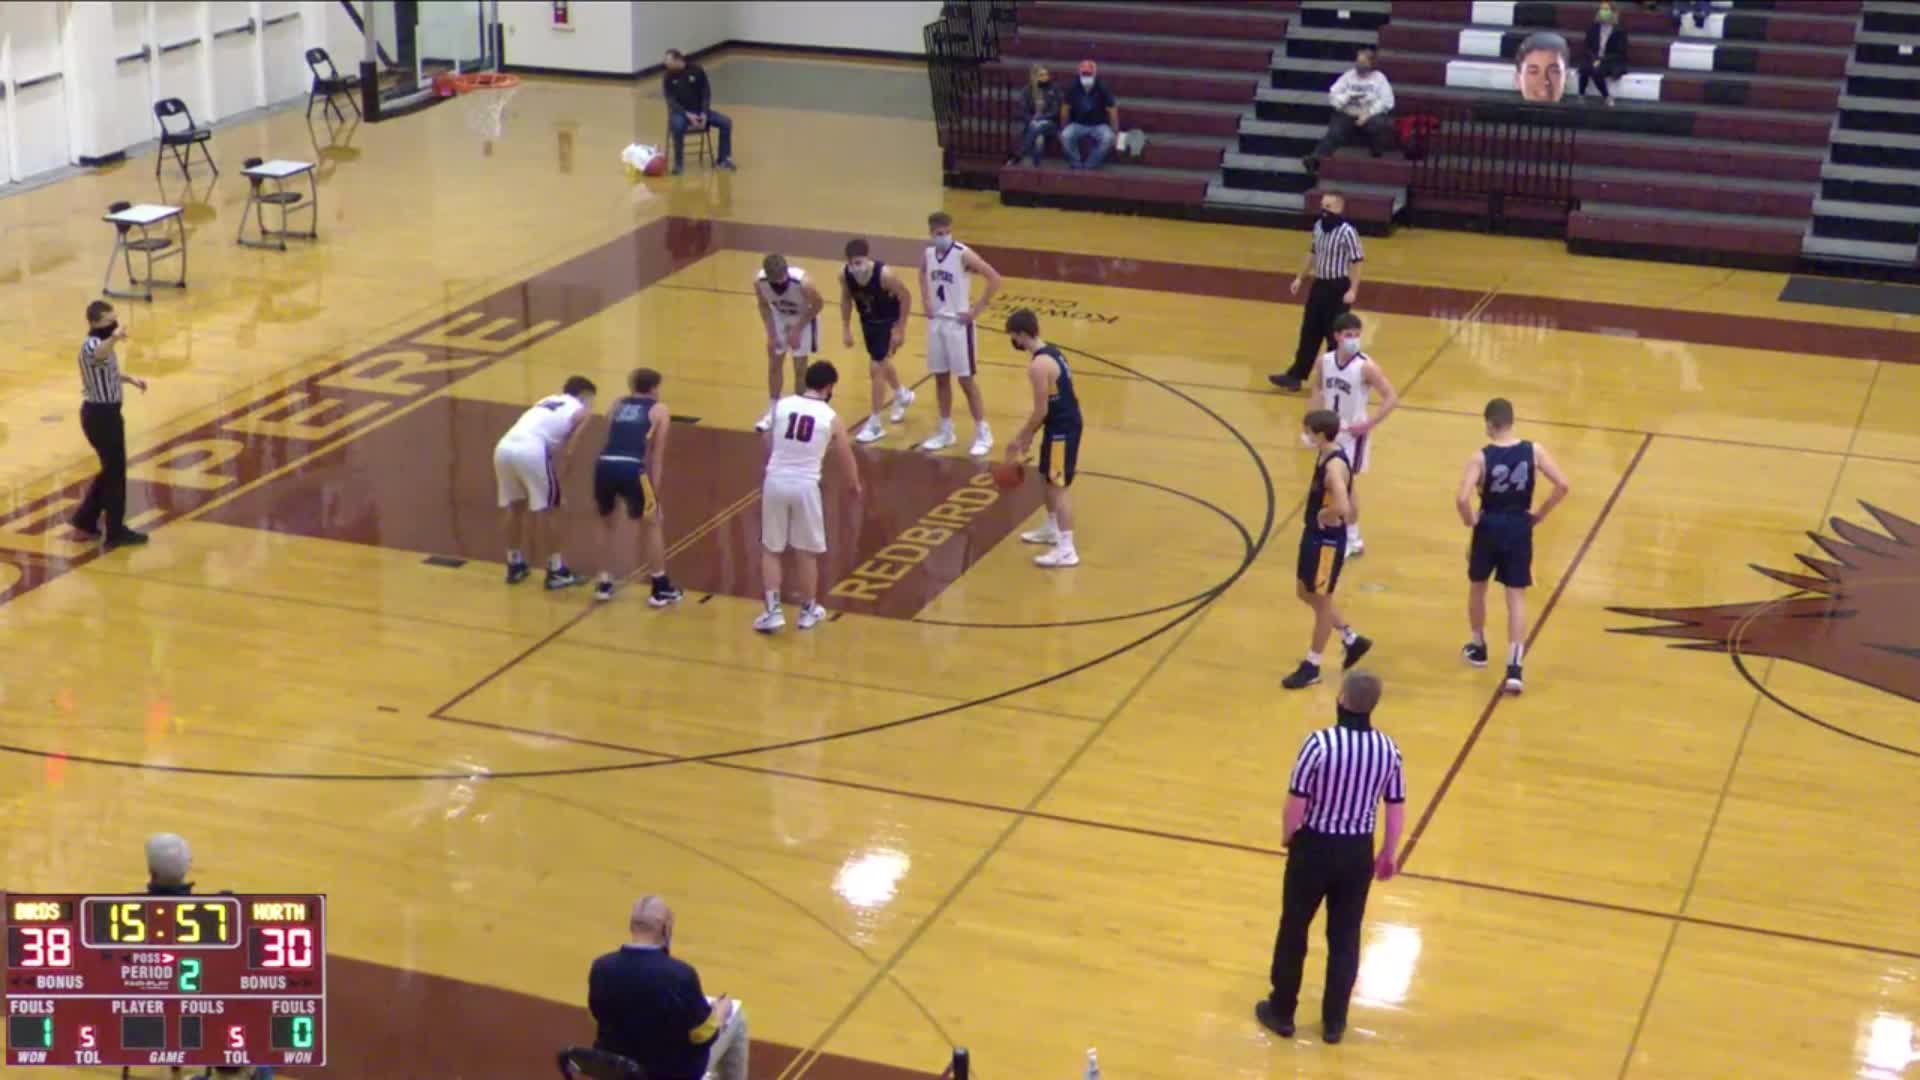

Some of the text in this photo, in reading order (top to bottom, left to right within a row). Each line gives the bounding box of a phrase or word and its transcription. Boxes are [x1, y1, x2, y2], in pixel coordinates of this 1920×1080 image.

[122, 311, 562, 491] PERE
[784, 412, 816, 443] 10
[1490, 460, 1529, 493] 24
